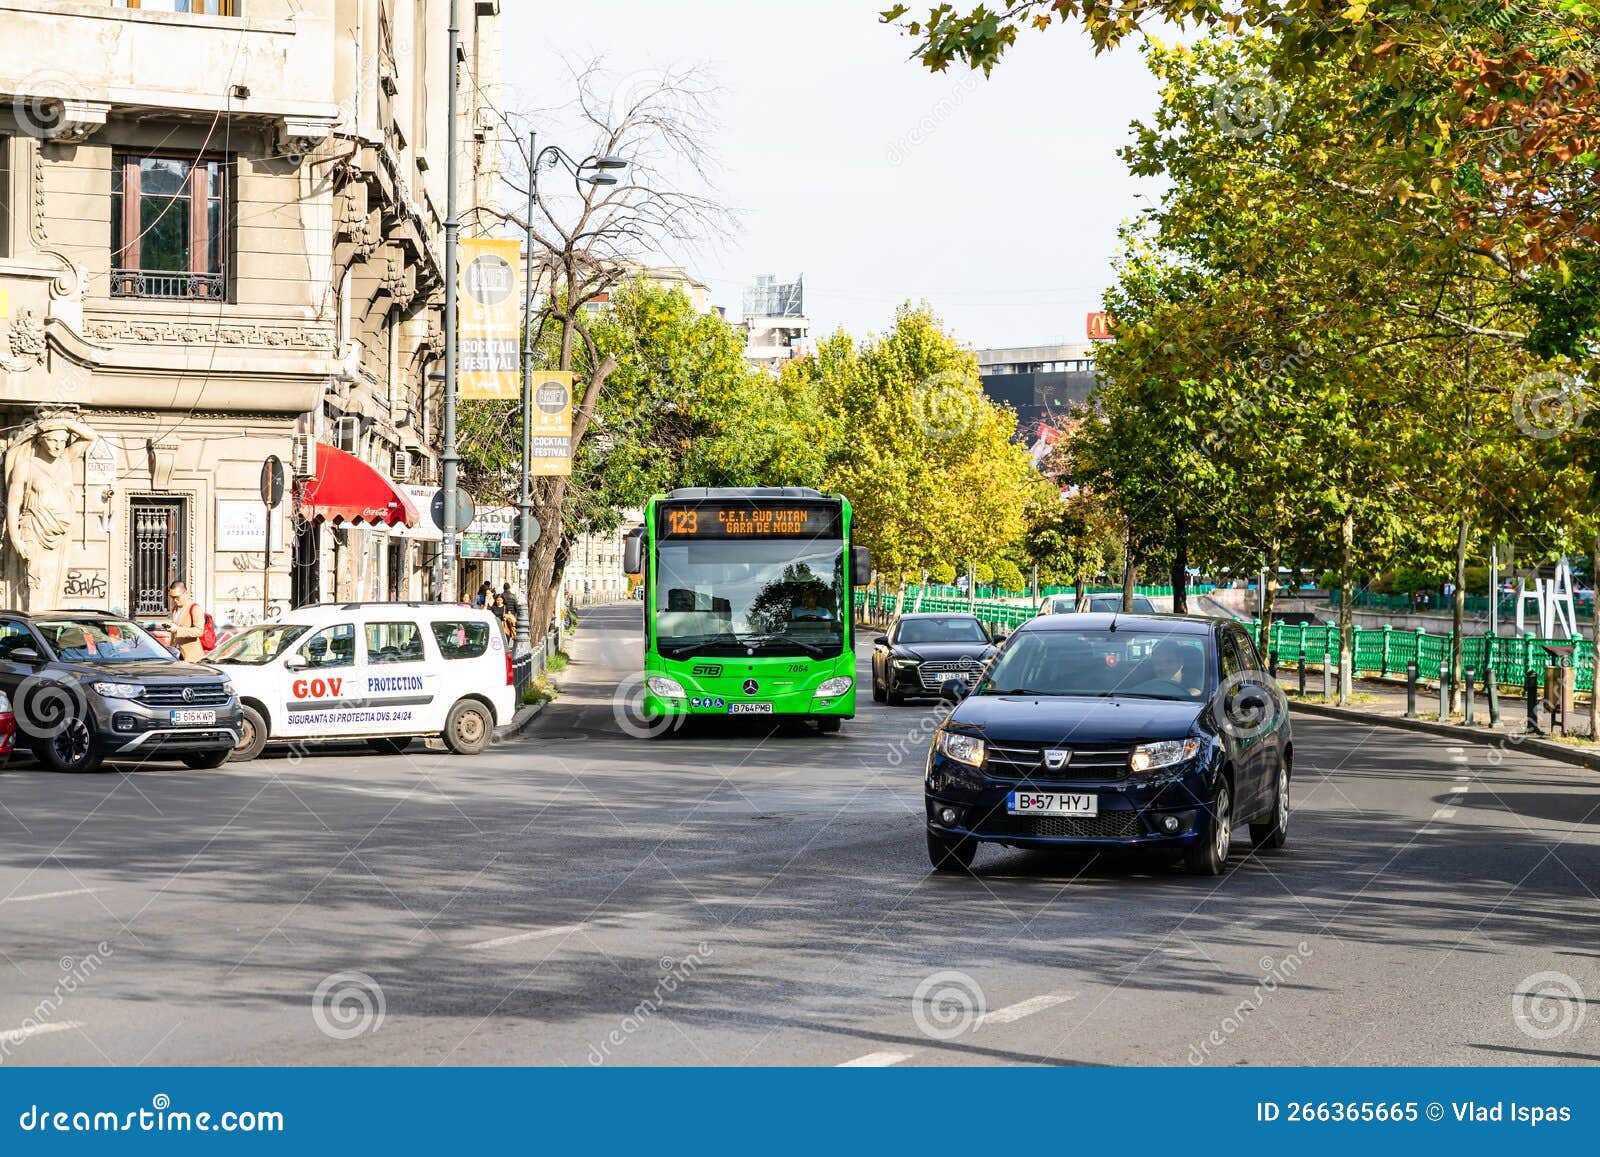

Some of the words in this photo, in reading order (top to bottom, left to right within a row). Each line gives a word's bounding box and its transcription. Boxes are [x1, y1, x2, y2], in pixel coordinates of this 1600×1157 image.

[463, 340, 515, 354] COCKTAIL
[464, 356, 514, 370] FESTIVAL
[534, 437, 569, 447] COCKTAIL
[535, 447, 568, 457] FESTIVAL
[668, 511, 698, 534] 123
[718, 510, 749, 522] C.E.T.
[752, 510, 773, 522] SUD
[775, 510, 808, 522] VITAN
[726, 522, 752, 533] GARA
[756, 522, 769, 533] DE
[773, 522, 801, 533] NORD
[692, 665, 720, 676] STB
[787, 664, 809, 673] 7064
[292, 677, 344, 699] G.O.V.
[368, 676, 423, 692] PROTECTION
[288, 713, 328, 725] SIGURANTA
[328, 712, 337, 723] SI
[337, 711, 375, 723] PROTECTIA
[1036, 794, 1054, 810] 57
[1060, 795, 1090, 810] HYJ
